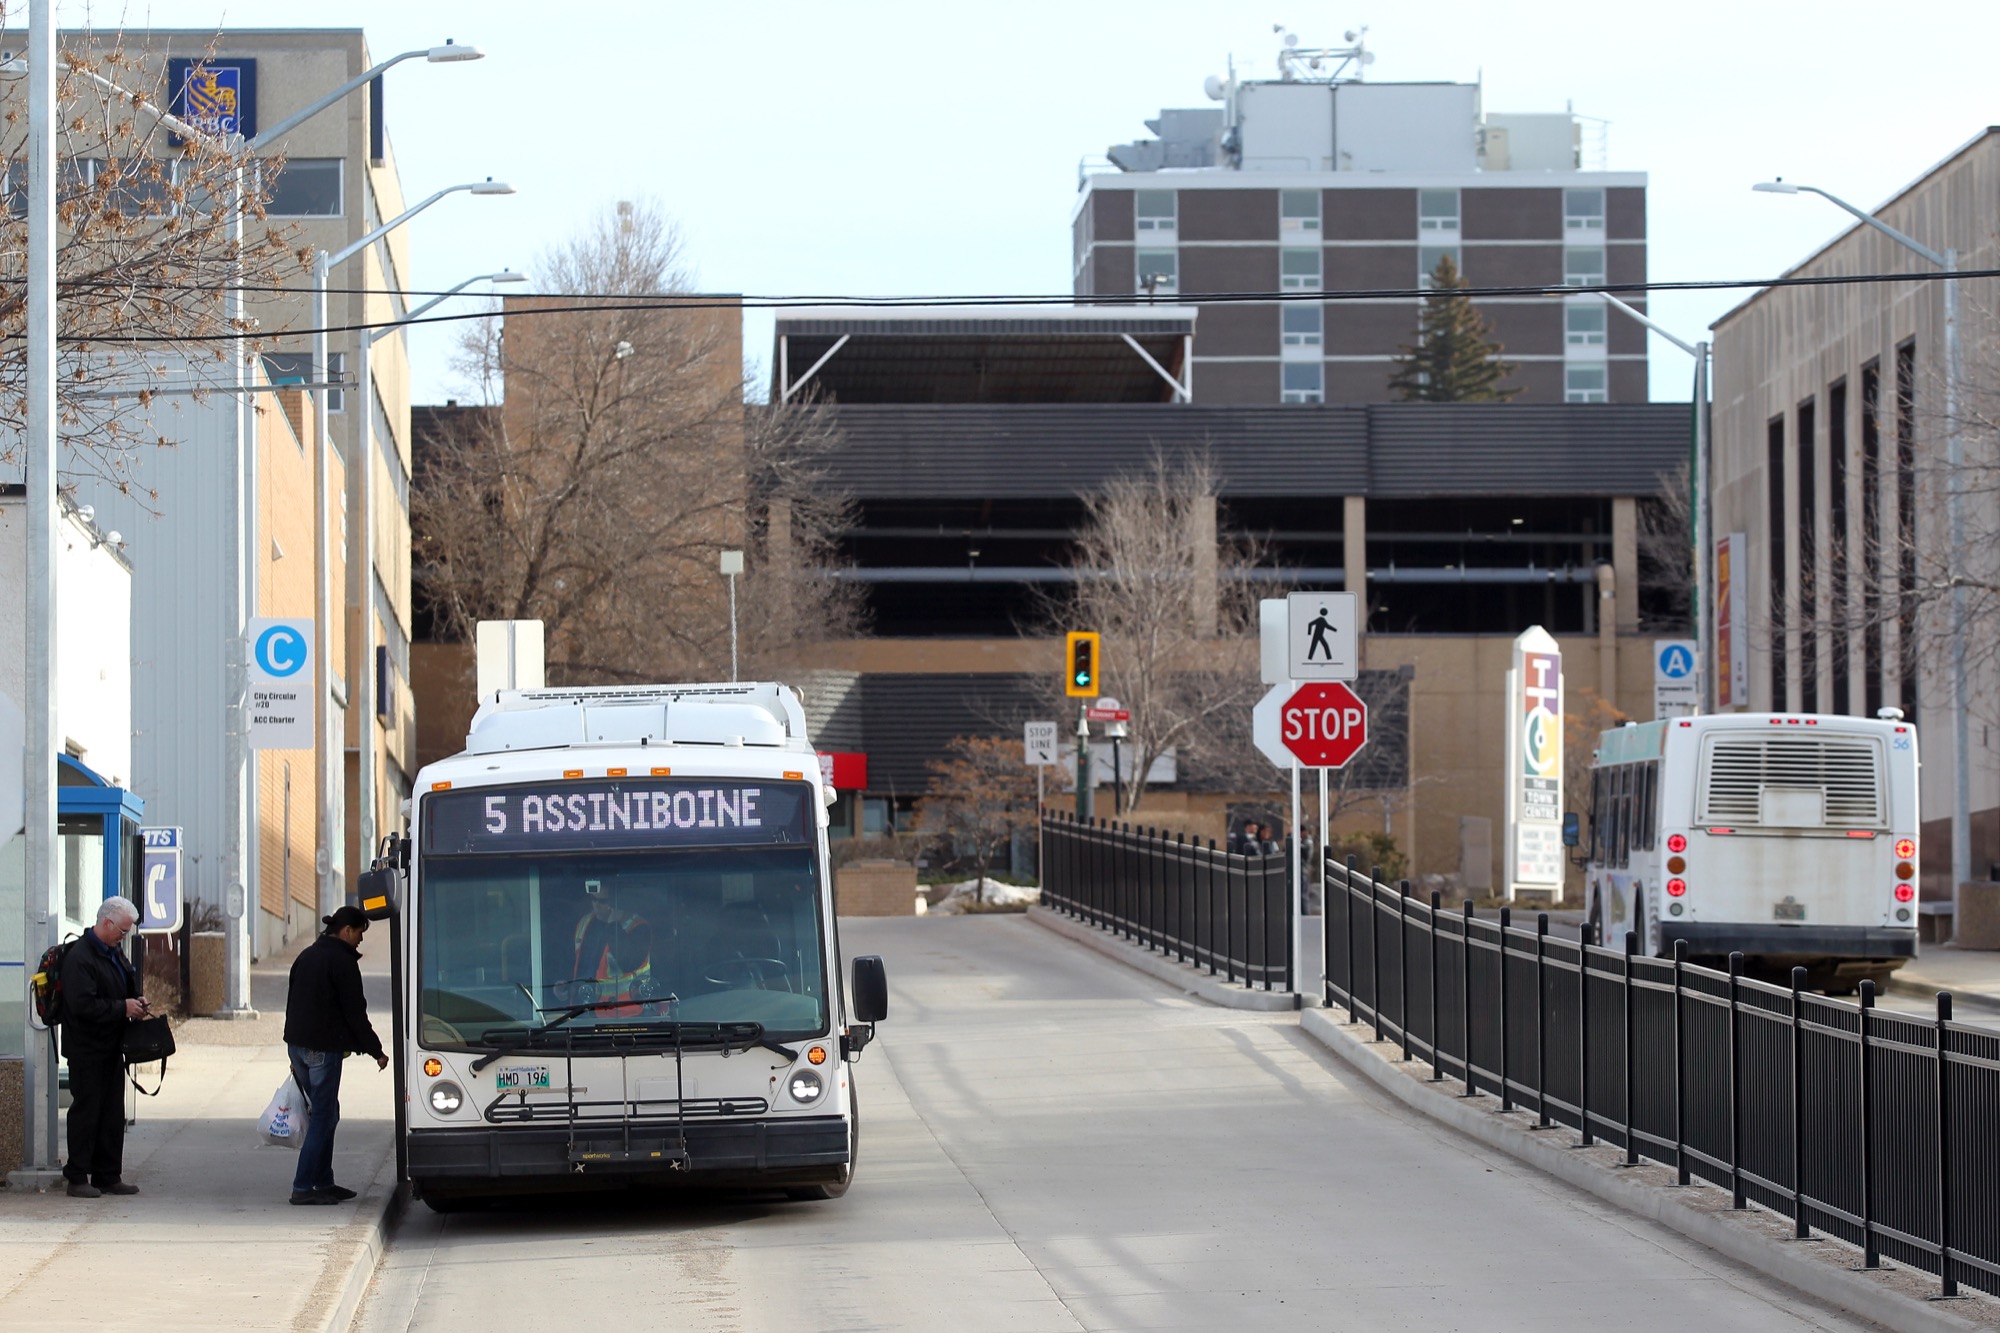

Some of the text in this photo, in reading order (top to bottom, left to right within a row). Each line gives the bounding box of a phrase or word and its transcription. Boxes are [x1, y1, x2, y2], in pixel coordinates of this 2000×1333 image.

[266, 631, 294, 670] C
[1665, 648, 1688, 674] A
[253, 692, 297, 702] City Circular
[253, 716, 295, 724] ACC Charter
[1284, 707, 1362, 741] STOP
[1029, 727, 1053, 738] STOP
[1031, 740, 1051, 749] LINE
[1526, 791, 1554, 804] TOWN
[485, 788, 762, 834] 5 ASSINIBOINE
[1524, 805, 1557, 819] CENTRE
[498, 1071, 547, 1086] HMD 196
